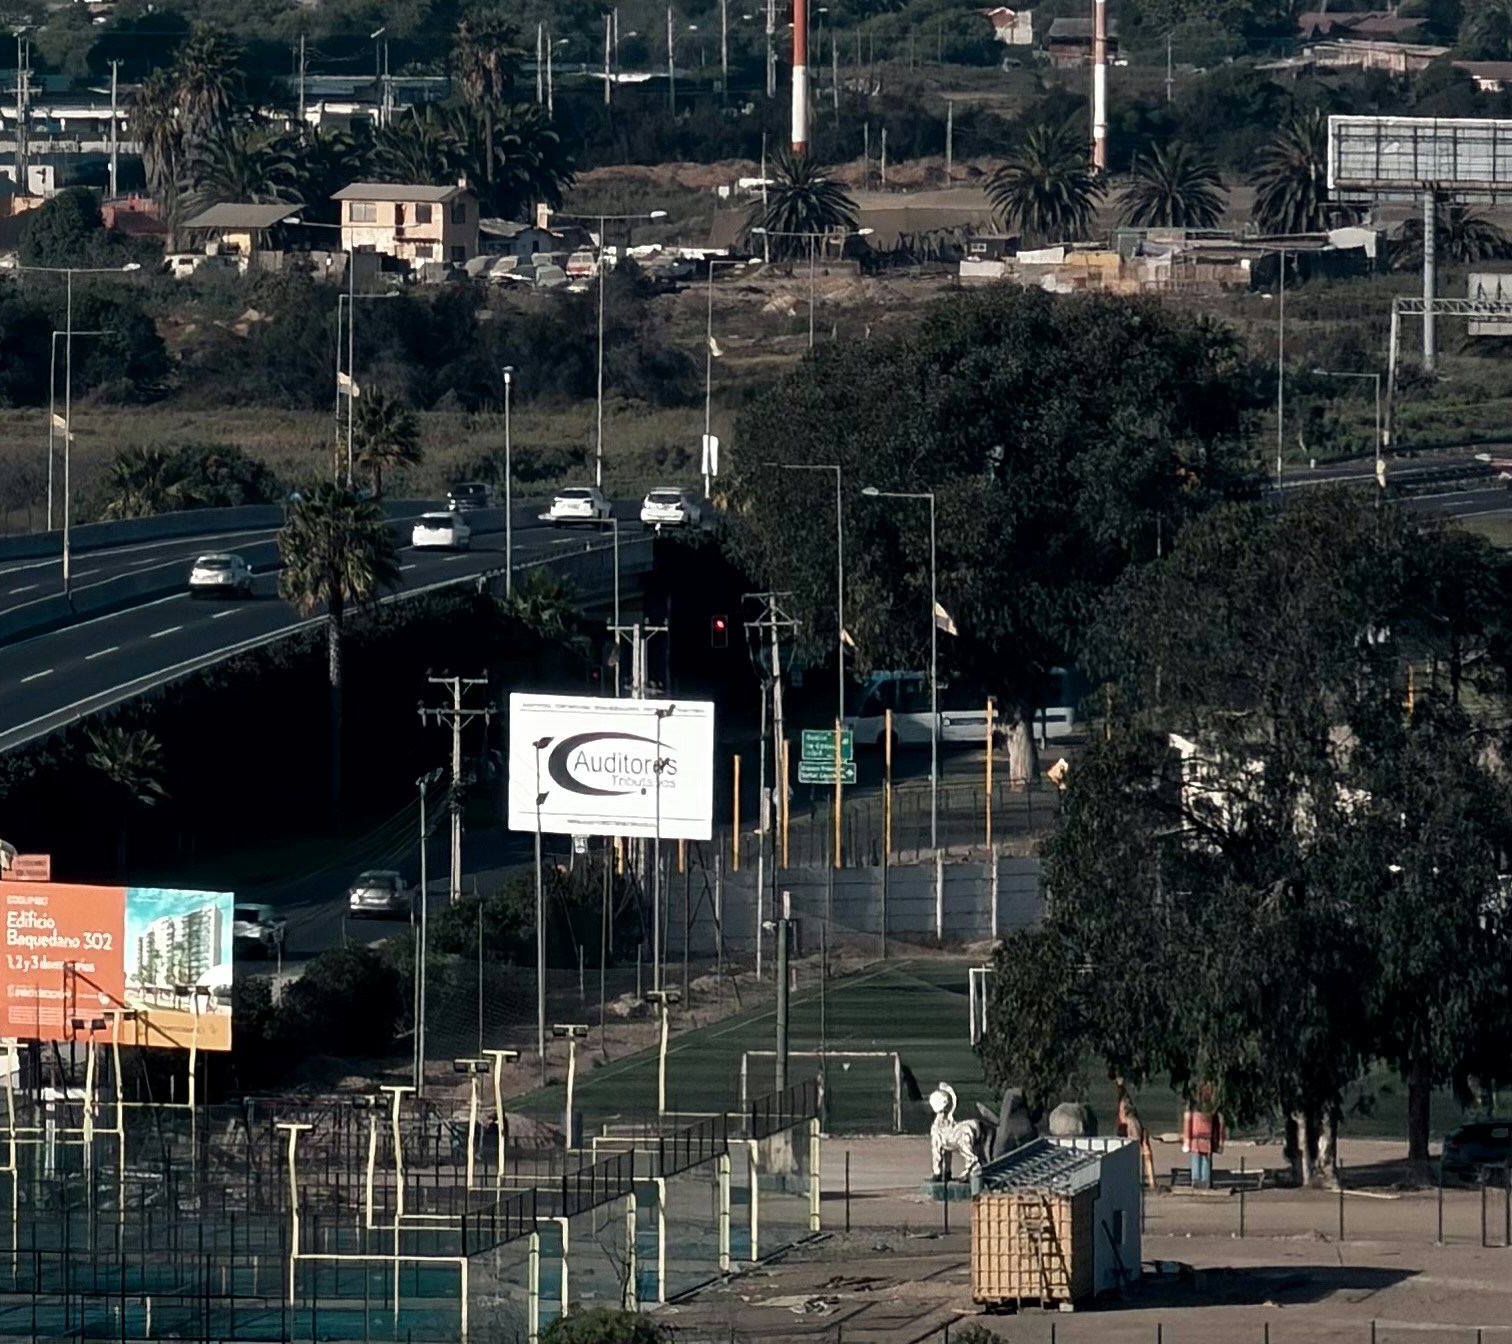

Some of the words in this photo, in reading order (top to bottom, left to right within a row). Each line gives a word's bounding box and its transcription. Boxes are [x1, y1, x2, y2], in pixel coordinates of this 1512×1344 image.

[573, 749, 678, 776] Auditores
[6, 909, 56, 929] Edificio
[6, 927, 81, 951] Baquedano
[82, 931, 113, 951] 302
[31, 954, 39, 969] 3
